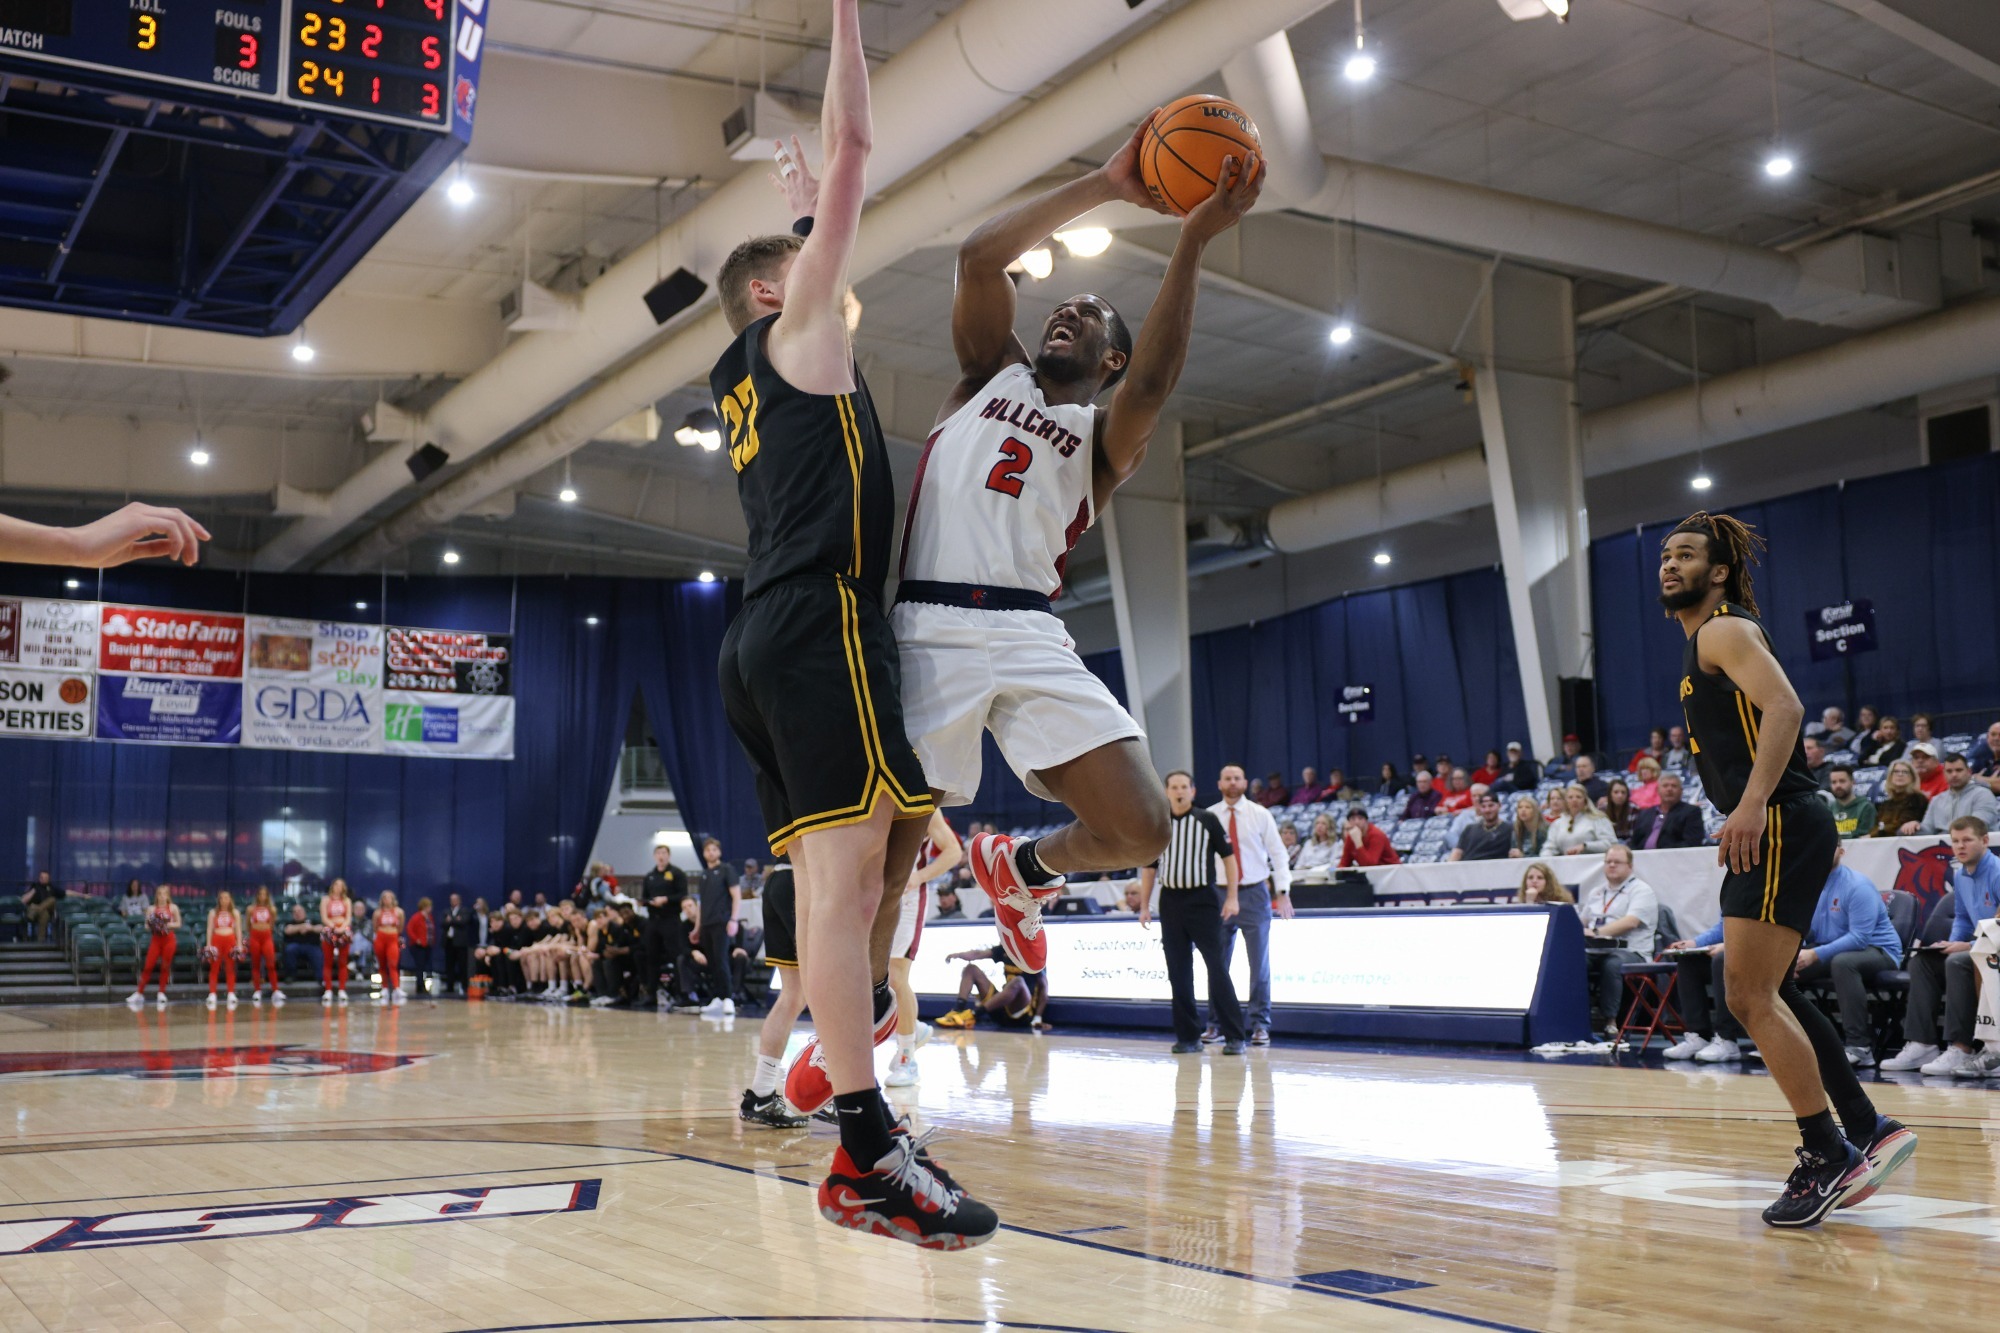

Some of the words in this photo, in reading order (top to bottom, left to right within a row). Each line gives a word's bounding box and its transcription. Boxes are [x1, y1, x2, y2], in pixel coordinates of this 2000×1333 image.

[137, 15, 157, 49] 3
[214, 9, 262, 32] FOULS
[239, 33, 258, 69] 3
[301, 12, 347, 51] 23
[361, 24, 383, 58] 2
[421, 36, 442, 69] 5
[212, 66, 261, 89] SCORE
[298, 60, 344, 97] 24
[372, 77, 381, 104] 1
[421, 83, 440, 116] 3
[720, 373, 760, 473] 23
[979, 397, 1083, 458] HLLCATS
[985, 436, 1034, 500] 2
[319, 621, 370, 641] Shop
[1815, 623, 1866, 643] Section
[109, 641, 141, 656] David
[203, 648, 235, 663] Agent
[336, 640, 380, 656] Dine
[1836, 639, 1848, 653] C
[318, 651, 361, 670] Stay
[337, 669, 378, 688] Play
[0, 681, 43, 702] SON
[255, 685, 371, 725] GRDA
[1338, 702, 1370, 713] Section
